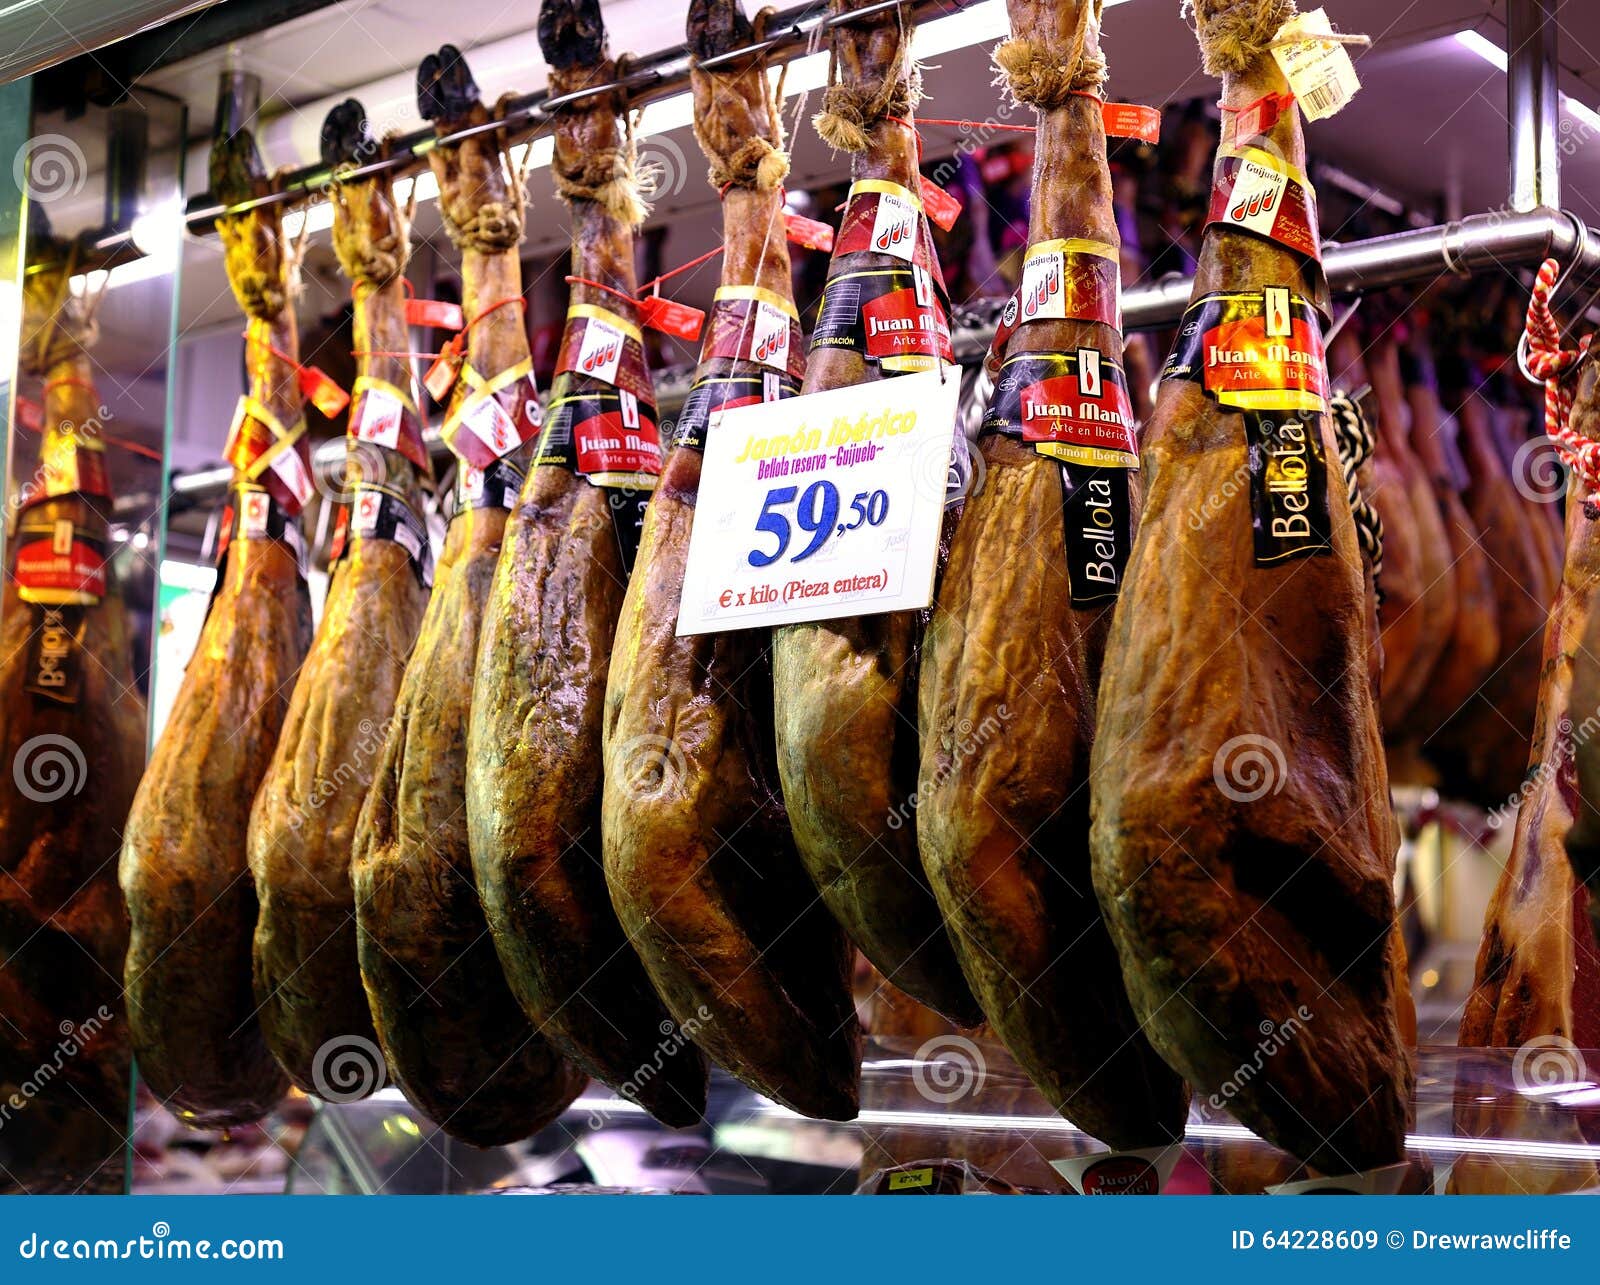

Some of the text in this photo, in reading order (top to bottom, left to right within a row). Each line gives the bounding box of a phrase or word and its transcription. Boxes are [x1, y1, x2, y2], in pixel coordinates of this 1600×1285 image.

[1246, 162, 1283, 183] Guijuelo
[869, 316, 914, 336] Juan
[822, 336, 855, 346] CURACIÓN
[893, 336, 916, 346] Arte
[1208, 345, 1259, 367] Juan
[1233, 369, 1261, 380] Arte
[1026, 401, 1073, 421] Juan
[1050, 420, 1073, 434] Arte
[1078, 427, 1091, 436] en
[580, 435, 621, 454] Juan
[735, 421, 822, 463] Jamón
[601, 454, 622, 464] Arte
[758, 457, 790, 480] Bellota
[791, 452, 827, 475] reserva
[1092, 449, 1132, 464] Ibérico
[1269, 422, 1311, 537] Bellota
[747, 480, 892, 567] 59,50
[1083, 480, 1116, 585] Bellota
[719, 568, 888, 608] € x kilo (Pieza entera)
[1098, 1173, 1137, 1186] Juan
